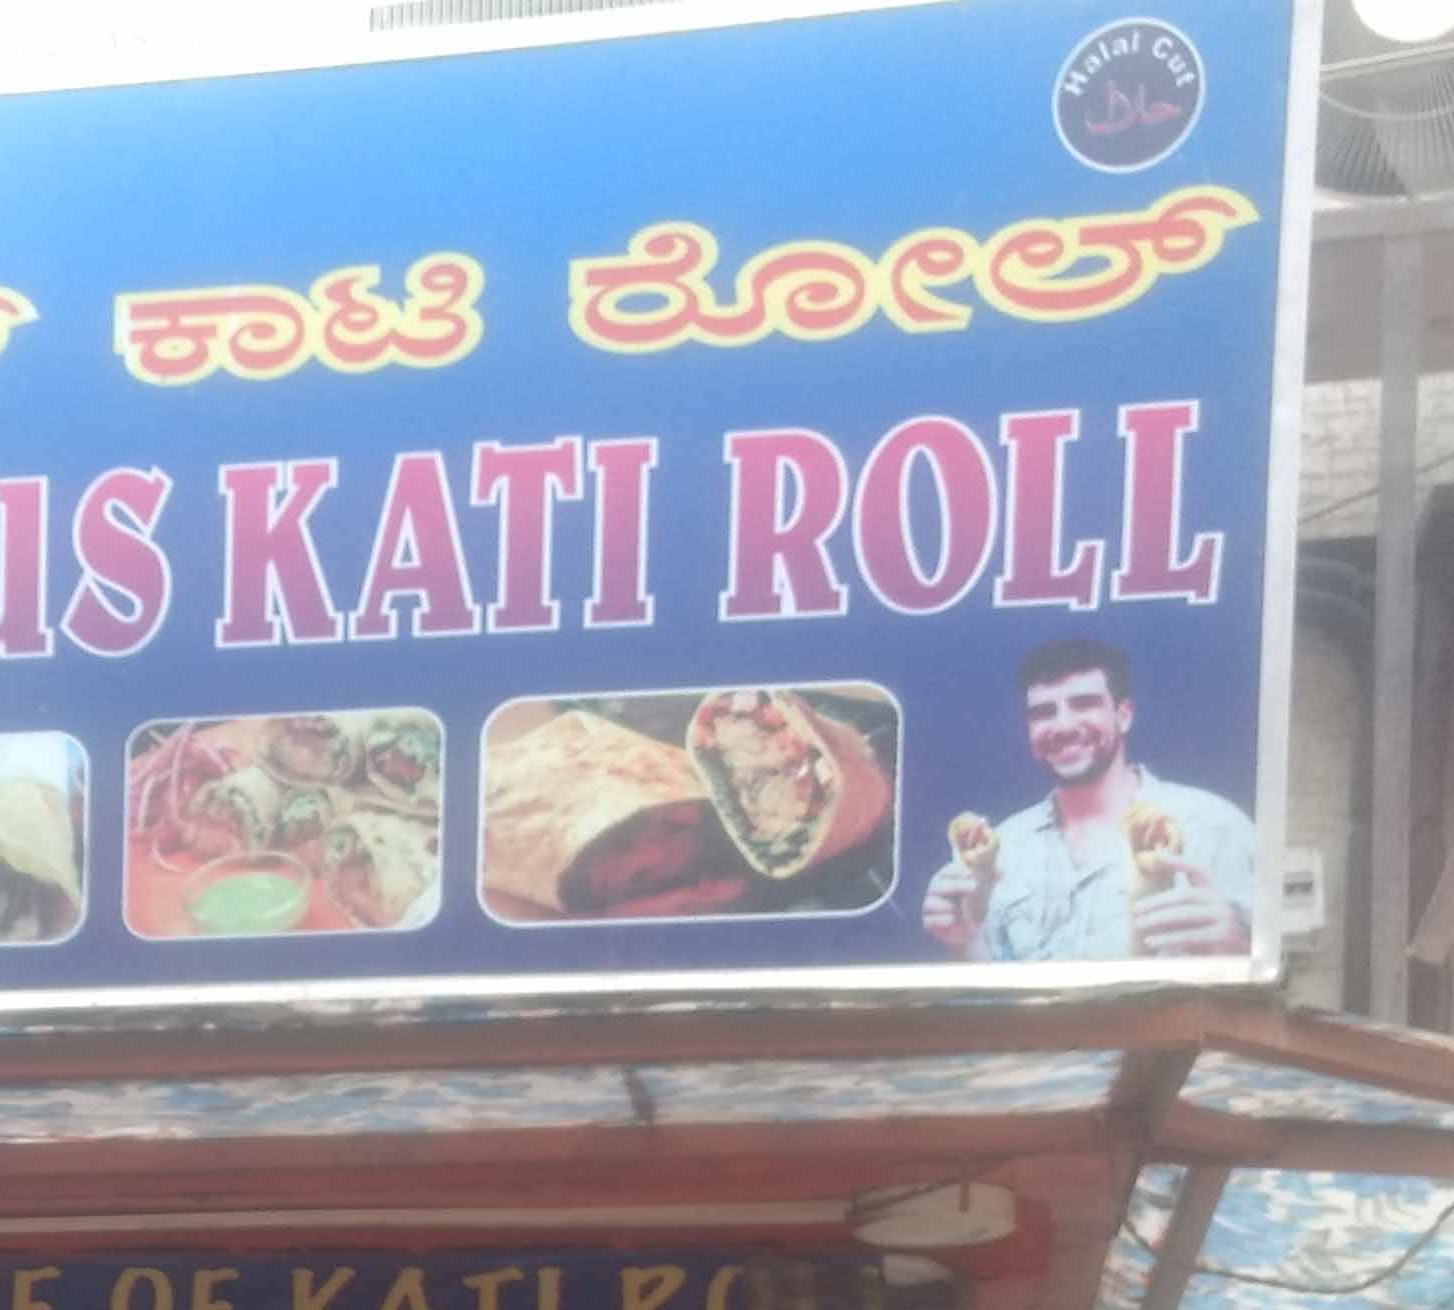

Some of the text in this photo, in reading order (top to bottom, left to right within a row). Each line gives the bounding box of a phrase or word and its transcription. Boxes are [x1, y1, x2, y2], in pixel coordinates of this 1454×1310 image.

[1062, 28, 1196, 96] Halal Cut
[569, 186, 1260, 353] ರೋಲ್
[215, 434, 659, 648] KATI
[718, 401, 1224, 621] ROLL
